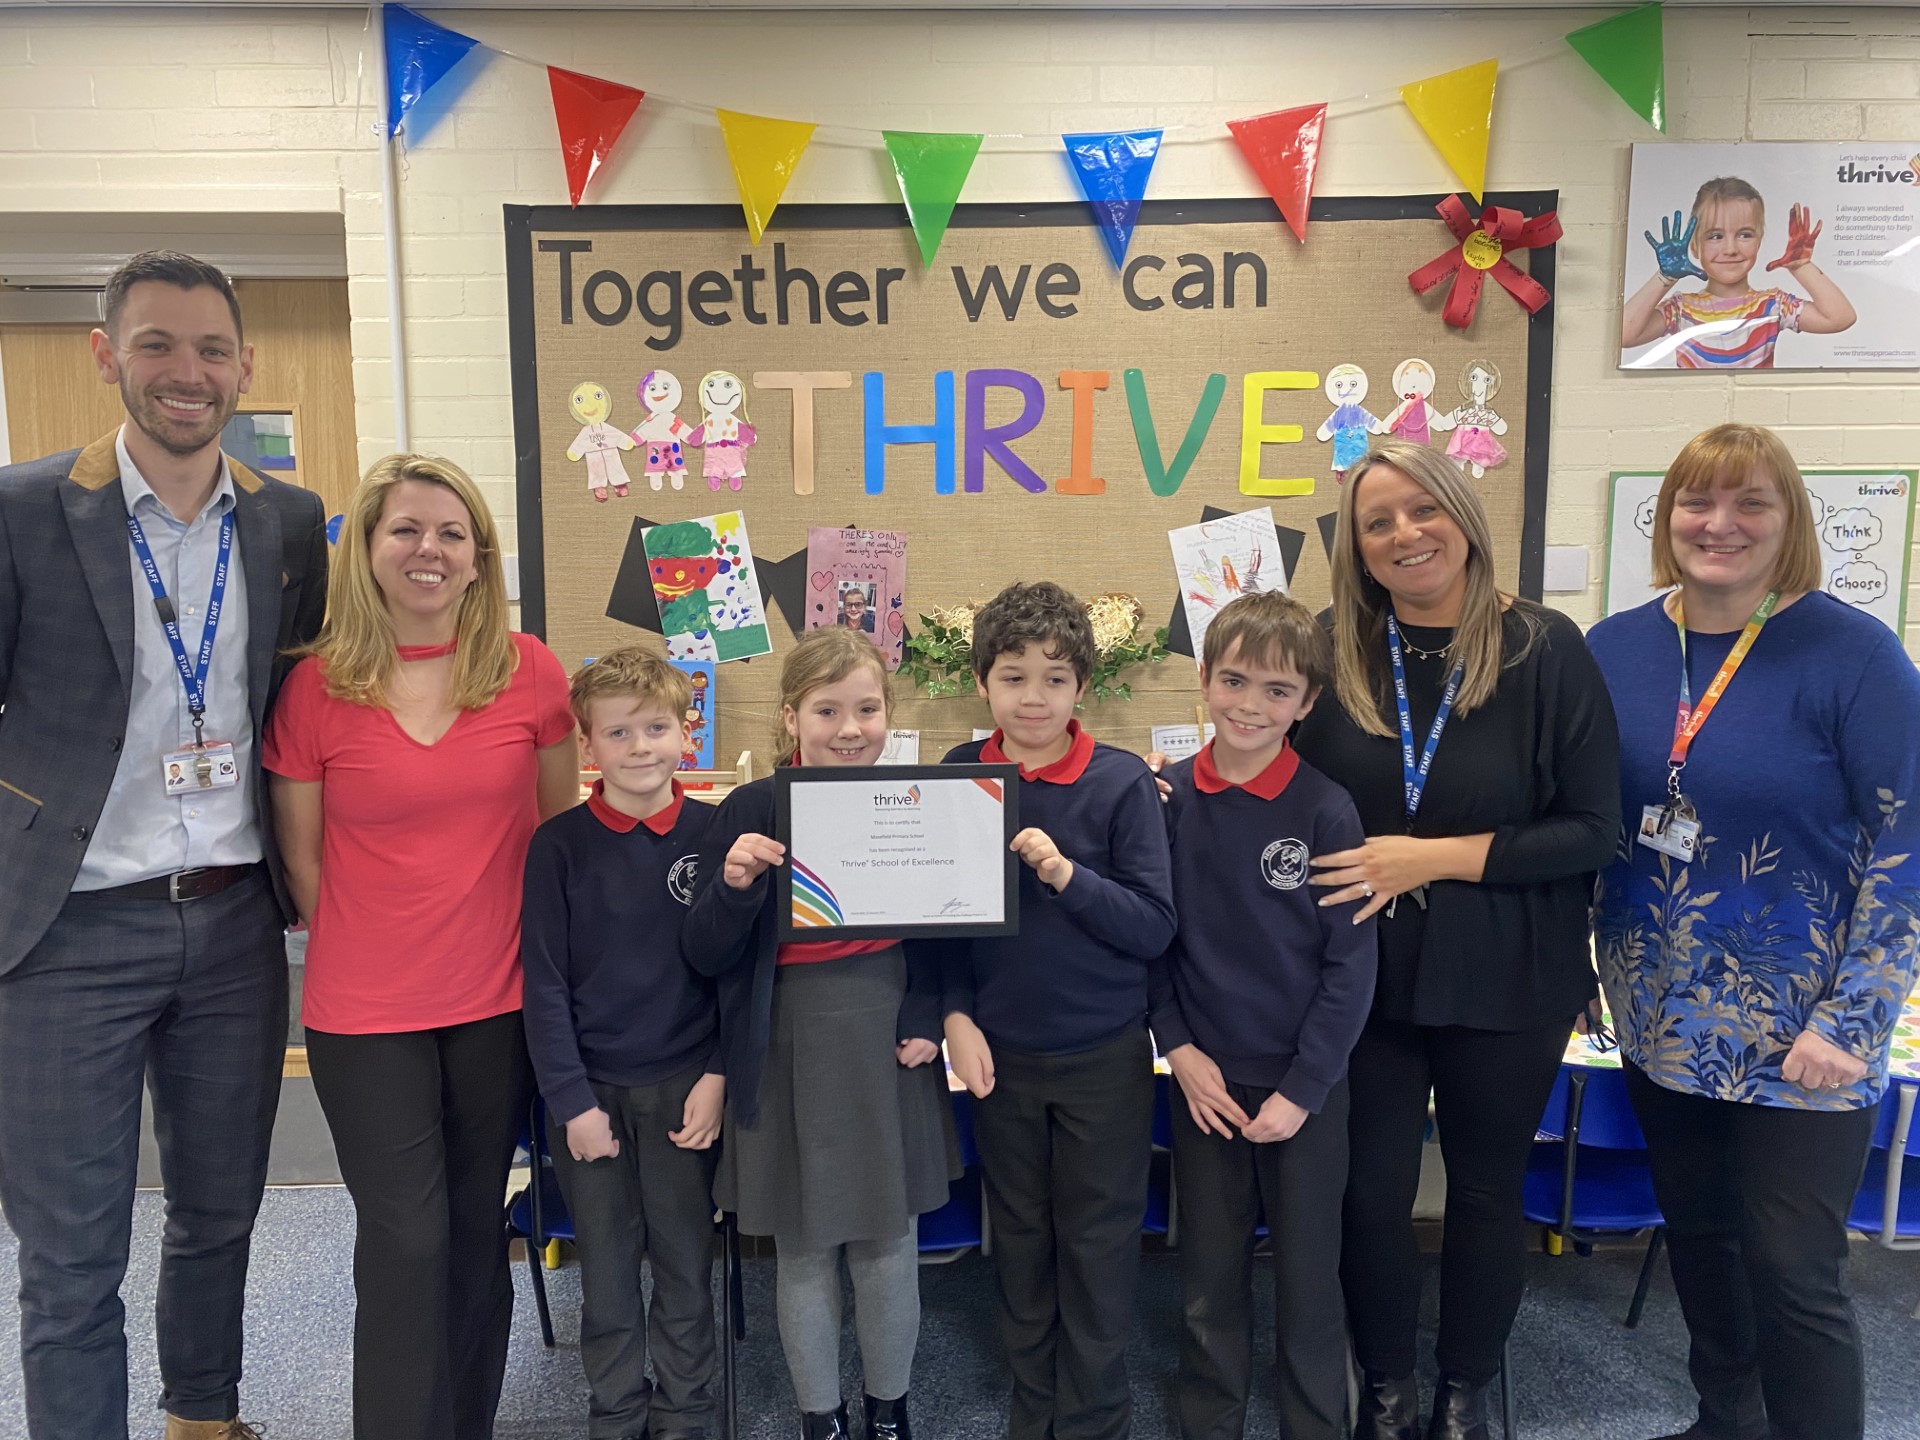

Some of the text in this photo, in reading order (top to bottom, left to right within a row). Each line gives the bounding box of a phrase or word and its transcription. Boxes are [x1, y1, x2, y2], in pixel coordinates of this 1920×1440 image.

[1855, 154, 1870, 163] help
[1870, 155, 1889, 163] every
[1837, 162, 1915, 183] thrive
[1835, 214, 1852, 223] why
[1852, 214, 1891, 223] somebody
[1840, 204, 1866, 213] always
[1867, 204, 1905, 212] wondered
[1833, 233, 1854, 241] these
[1846, 224, 1886, 232] something
[1896, 223, 1913, 232] help
[538, 240, 1268, 351] Together we can
[753, 368, 1320, 498] THRIVE
[1858, 484, 1901, 495] thrive
[128, 519, 143, 545] STAFF
[222, 525, 231, 549] STAFF
[1832, 525, 1872, 539] Think
[143, 558, 159, 584] STAFF
[216, 562, 225, 587] STAFF
[1834, 576, 1881, 590] Choose
[208, 600, 220, 626] STAFF
[166, 621, 179, 640] TAFF
[200, 639, 211, 665] STAFF
[1391, 646, 1401, 667] STAFF
[177, 654, 193, 679] STAFF
[1395, 678, 1405, 700] STAFF
[1710, 670, 1727, 693] thrive
[1444, 682, 1456, 705] STAFF
[1400, 710, 1410, 732] STAFF
[1431, 716, 1444, 739] STAFF
[1687, 710, 1703, 733] thrive
[893, 731, 912, 739] thrive
[1404, 744, 1413, 768] STAFF
[1420, 751, 1431, 775] STAFF
[873, 793, 912, 806] thrive
[1409, 786, 1420, 811] STAFF
[871, 858, 899, 867] School
[901, 858, 910, 866] of
[911, 857, 955, 866] Excellence
